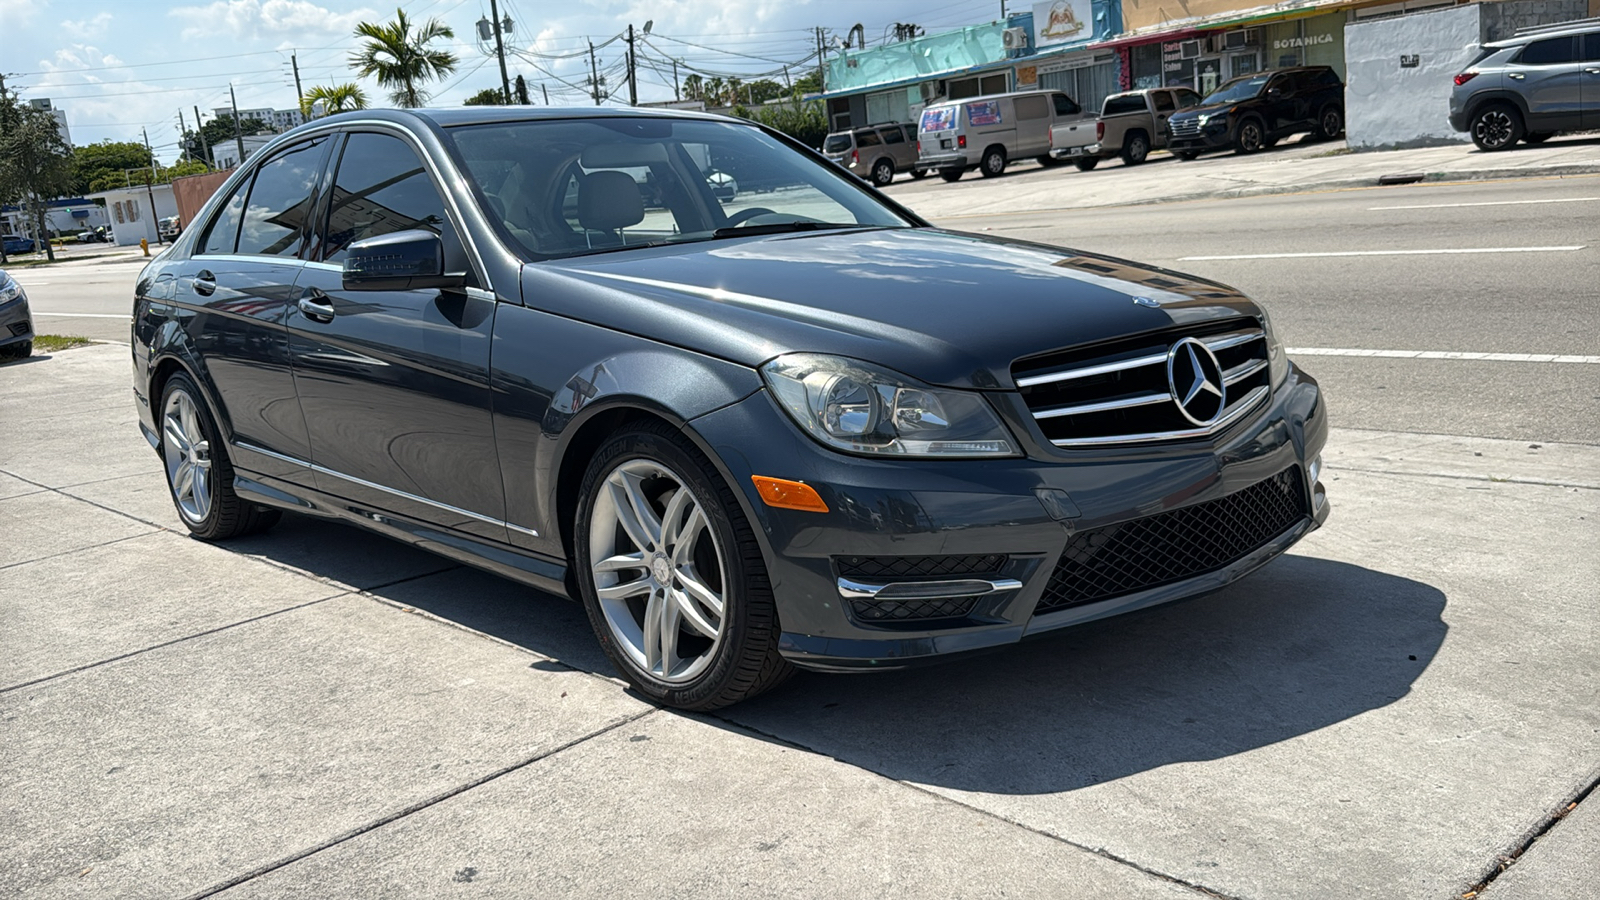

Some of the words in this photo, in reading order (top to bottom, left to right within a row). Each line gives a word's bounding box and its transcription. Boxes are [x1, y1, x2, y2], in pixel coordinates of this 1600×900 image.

[1274, 33, 1333, 49] BOTANICA
[1164, 52, 1181, 62] Beaut
[1164, 63, 1182, 72] Salon
[579, 440, 627, 498] ANDGOLDEN
